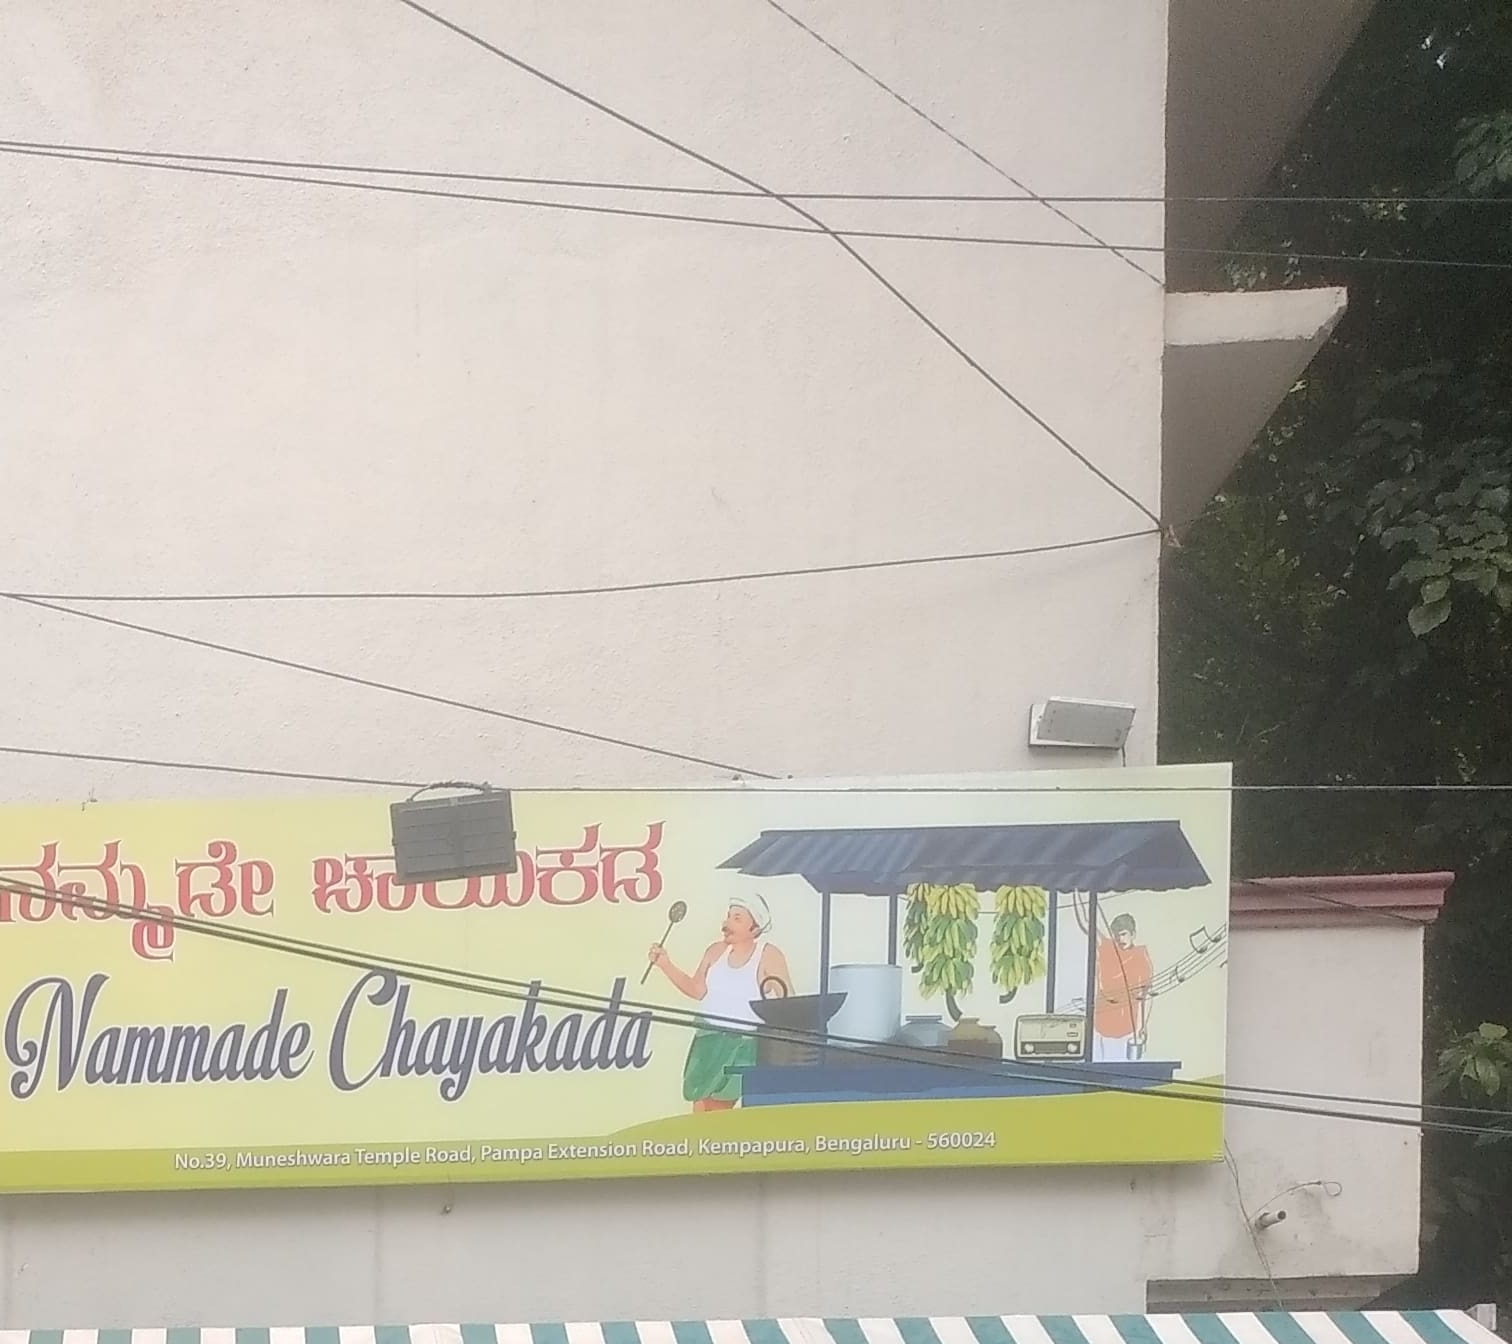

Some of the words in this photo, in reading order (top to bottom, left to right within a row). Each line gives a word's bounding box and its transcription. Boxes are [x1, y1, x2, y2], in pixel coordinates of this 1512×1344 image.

[4, 972, 315, 1100] Nammade
[329, 968, 654, 1102] Chayakada
[174, 1152, 232, 1171] No.39,
[236, 1149, 351, 1169] Muneshwara
[354, 1147, 421, 1168] Temple
[425, 1145, 476, 1165] Road,
[480, 1145, 543, 1164] Pampa
[547, 1142, 637, 1160] Extension
[642, 1139, 693, 1157] Road,
[698, 1138, 810, 1157] Kempapura,
[815, 1134, 911, 1156] Bengaluru
[926, 1132, 996, 1149] 560024
